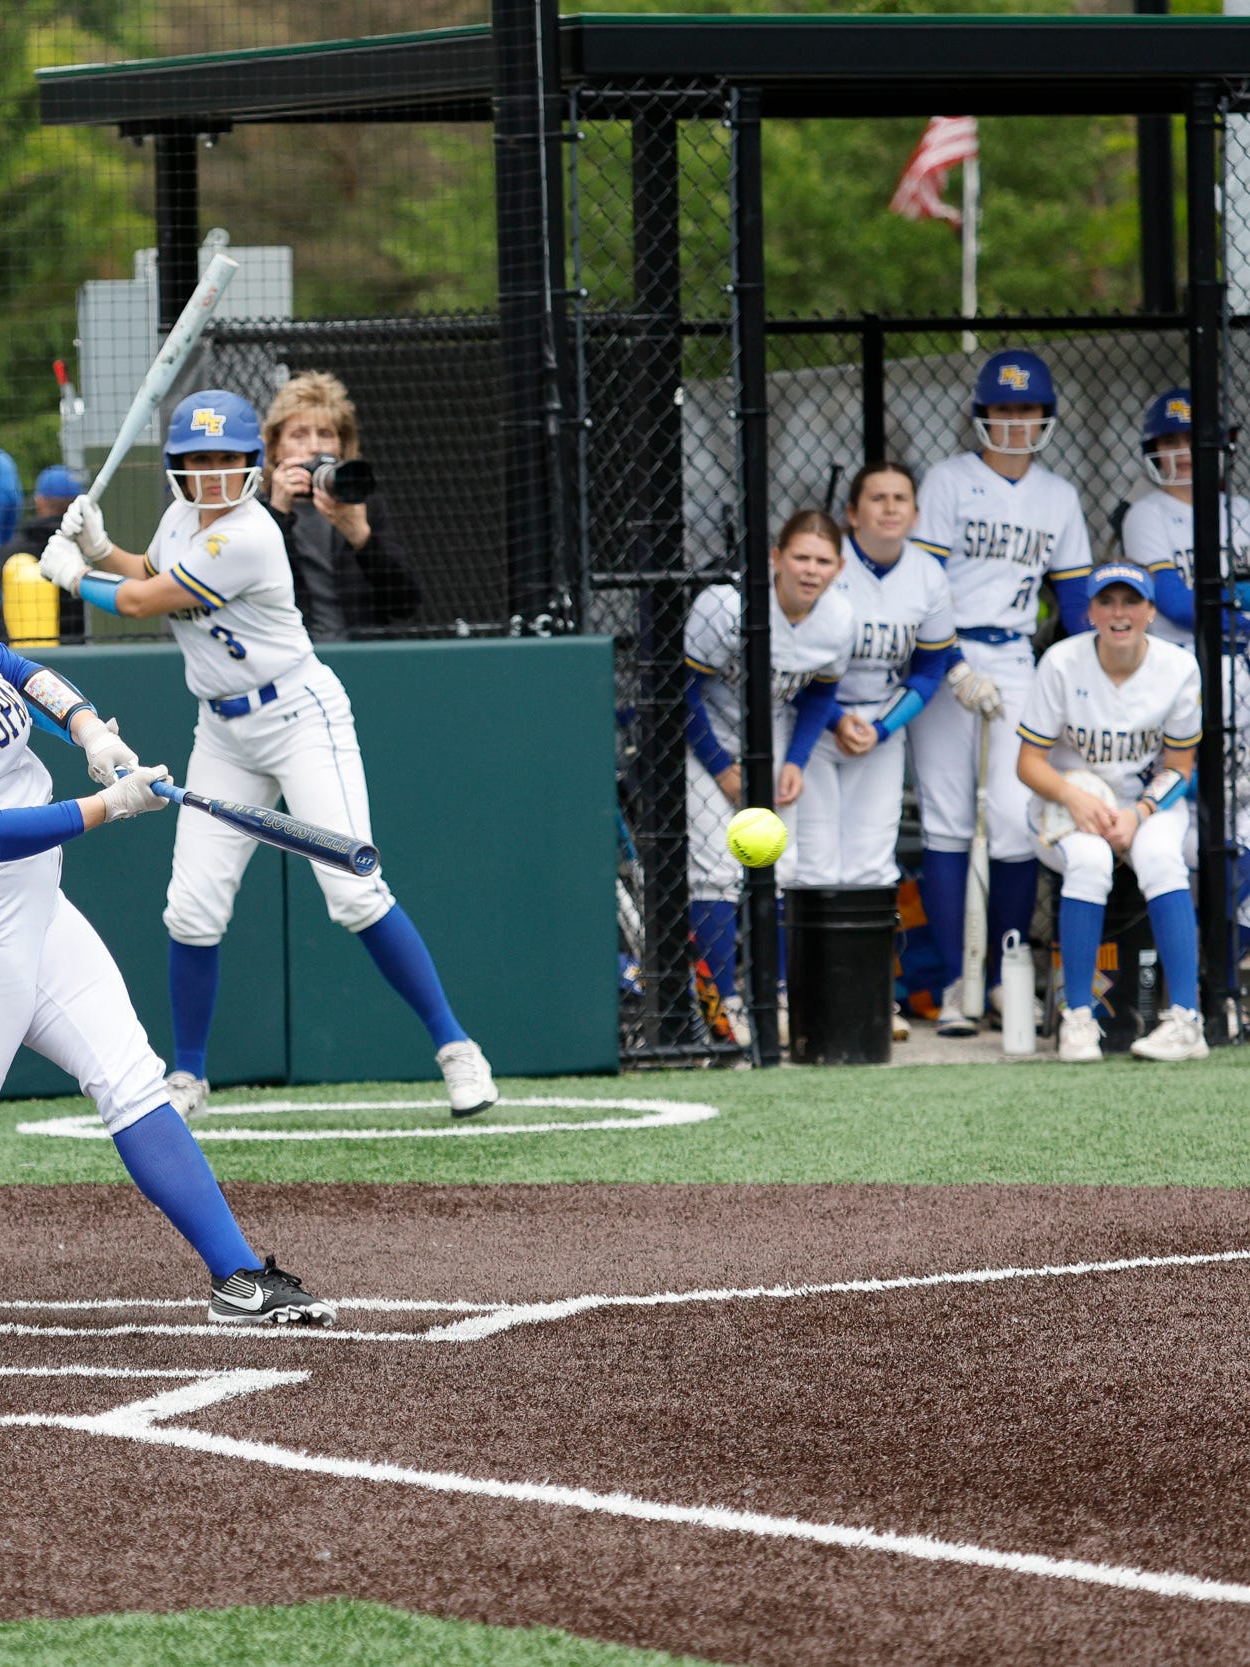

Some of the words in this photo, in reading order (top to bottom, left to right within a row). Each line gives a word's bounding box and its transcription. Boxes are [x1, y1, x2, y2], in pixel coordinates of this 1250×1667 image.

[999, 366, 1029, 390] ME
[192, 409, 225, 435] ME
[964, 520, 1054, 567] SPARTANS
[210, 625, 247, 661] 3
[1066, 725, 1163, 763] SPARTANS
[356, 855, 374, 865] LXT
